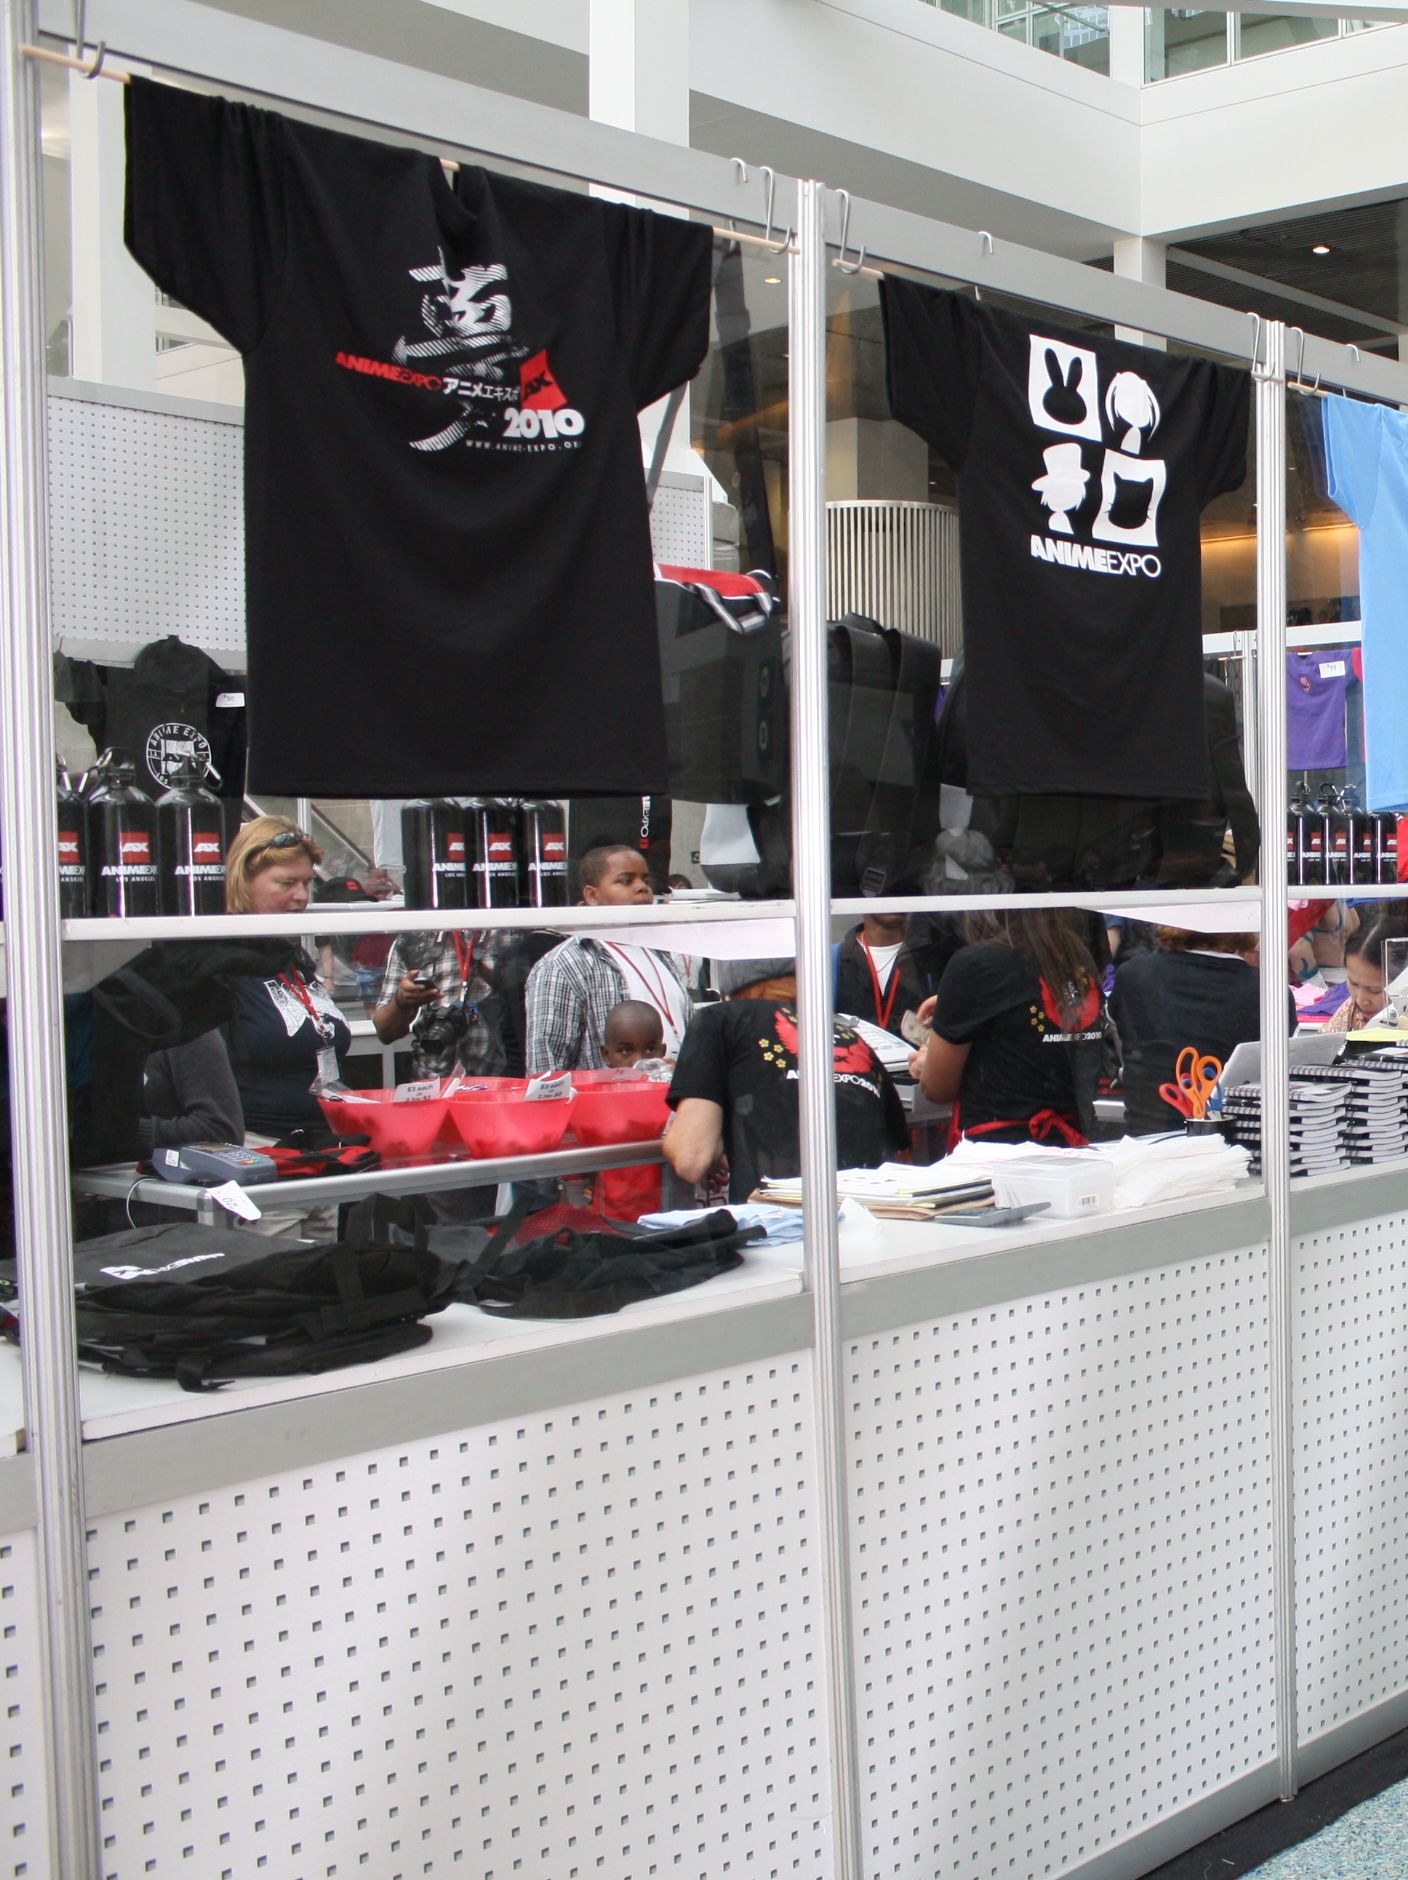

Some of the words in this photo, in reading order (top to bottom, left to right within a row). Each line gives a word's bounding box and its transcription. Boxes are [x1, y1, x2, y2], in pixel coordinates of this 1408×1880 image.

[503, 407, 585, 438] 2010
[1030, 534, 1161, 578] ANIMEEXPO
[432, 862, 466, 872] ANIME
